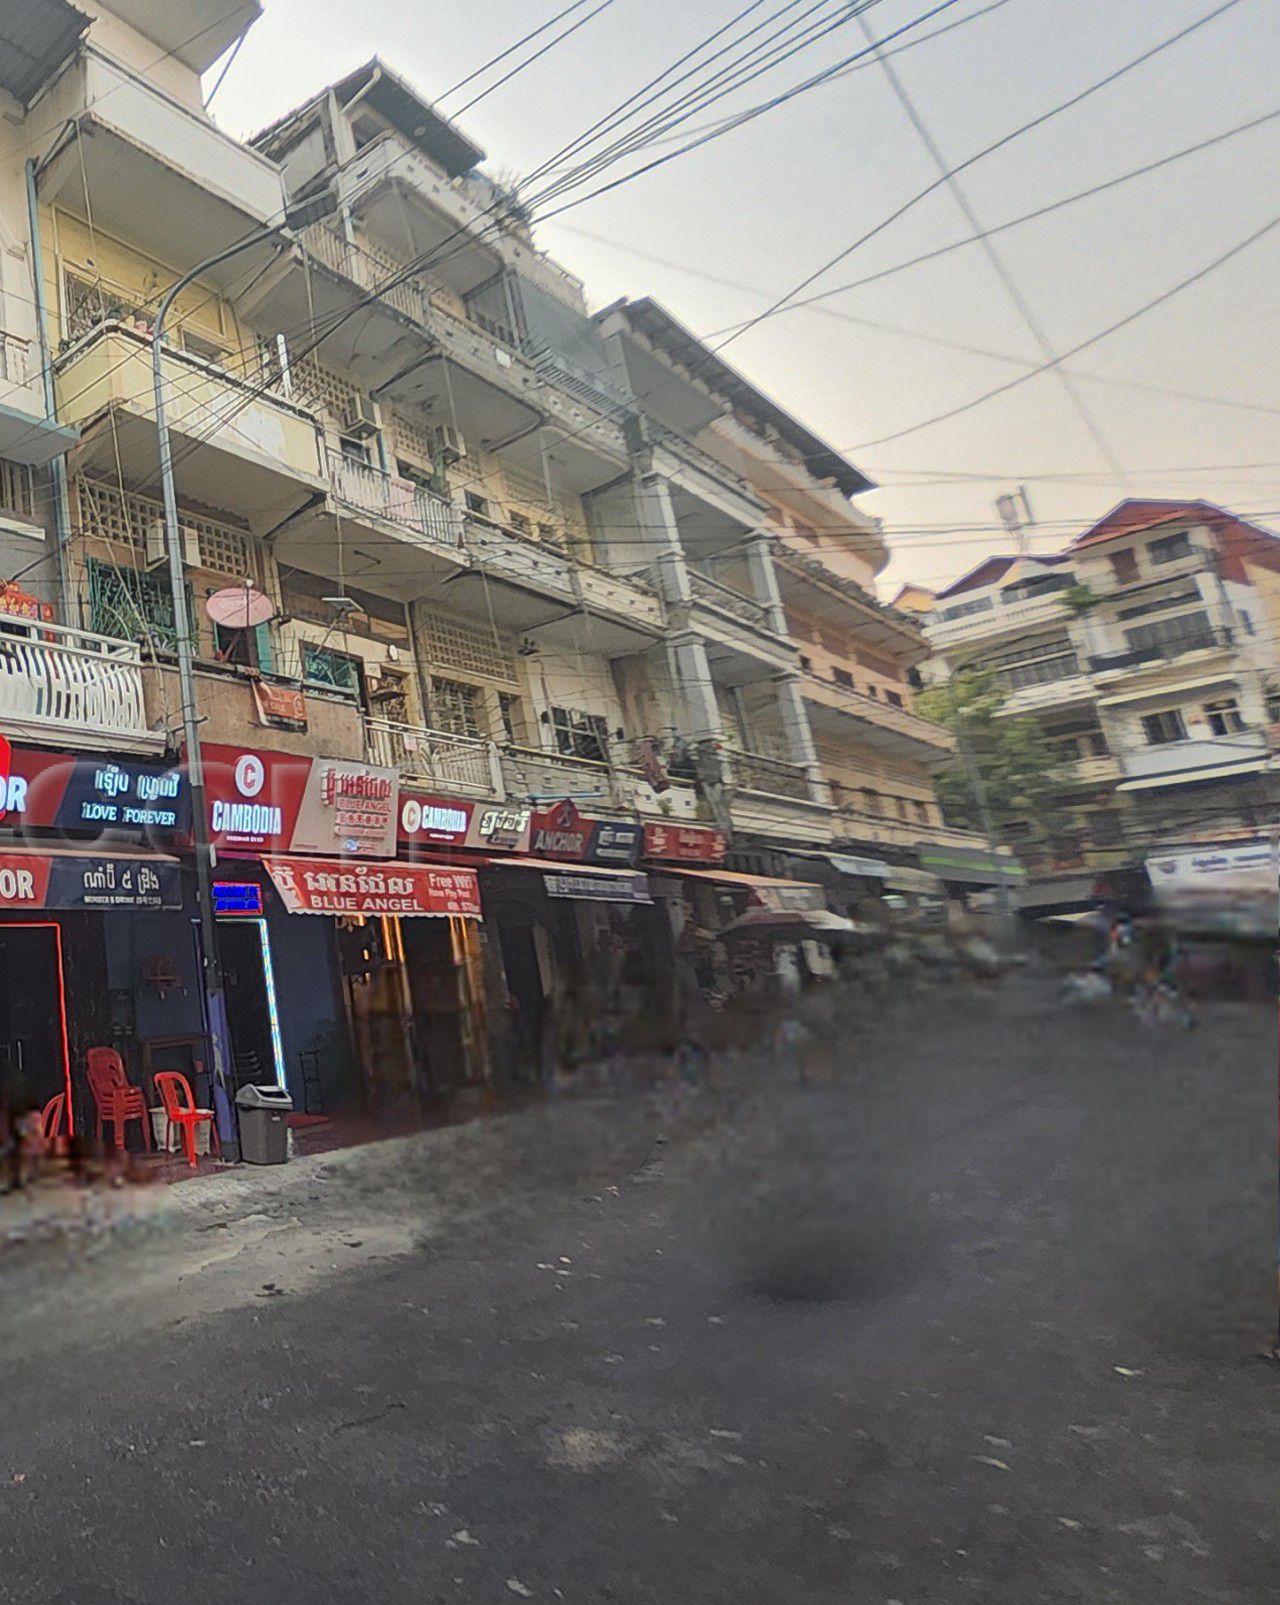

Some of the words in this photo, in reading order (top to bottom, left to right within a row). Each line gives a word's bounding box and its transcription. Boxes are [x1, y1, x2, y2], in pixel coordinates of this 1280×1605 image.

[82, 802, 117, 821] LOVE
[123, 807, 176, 825] FOREVER
[212, 800, 282, 835] CAMBODIA
[534, 830, 584, 852] ANCHOR
[428, 873, 452, 888] Free
[310, 895, 357, 910] BLUE
[362, 898, 425, 911] ANGEL
